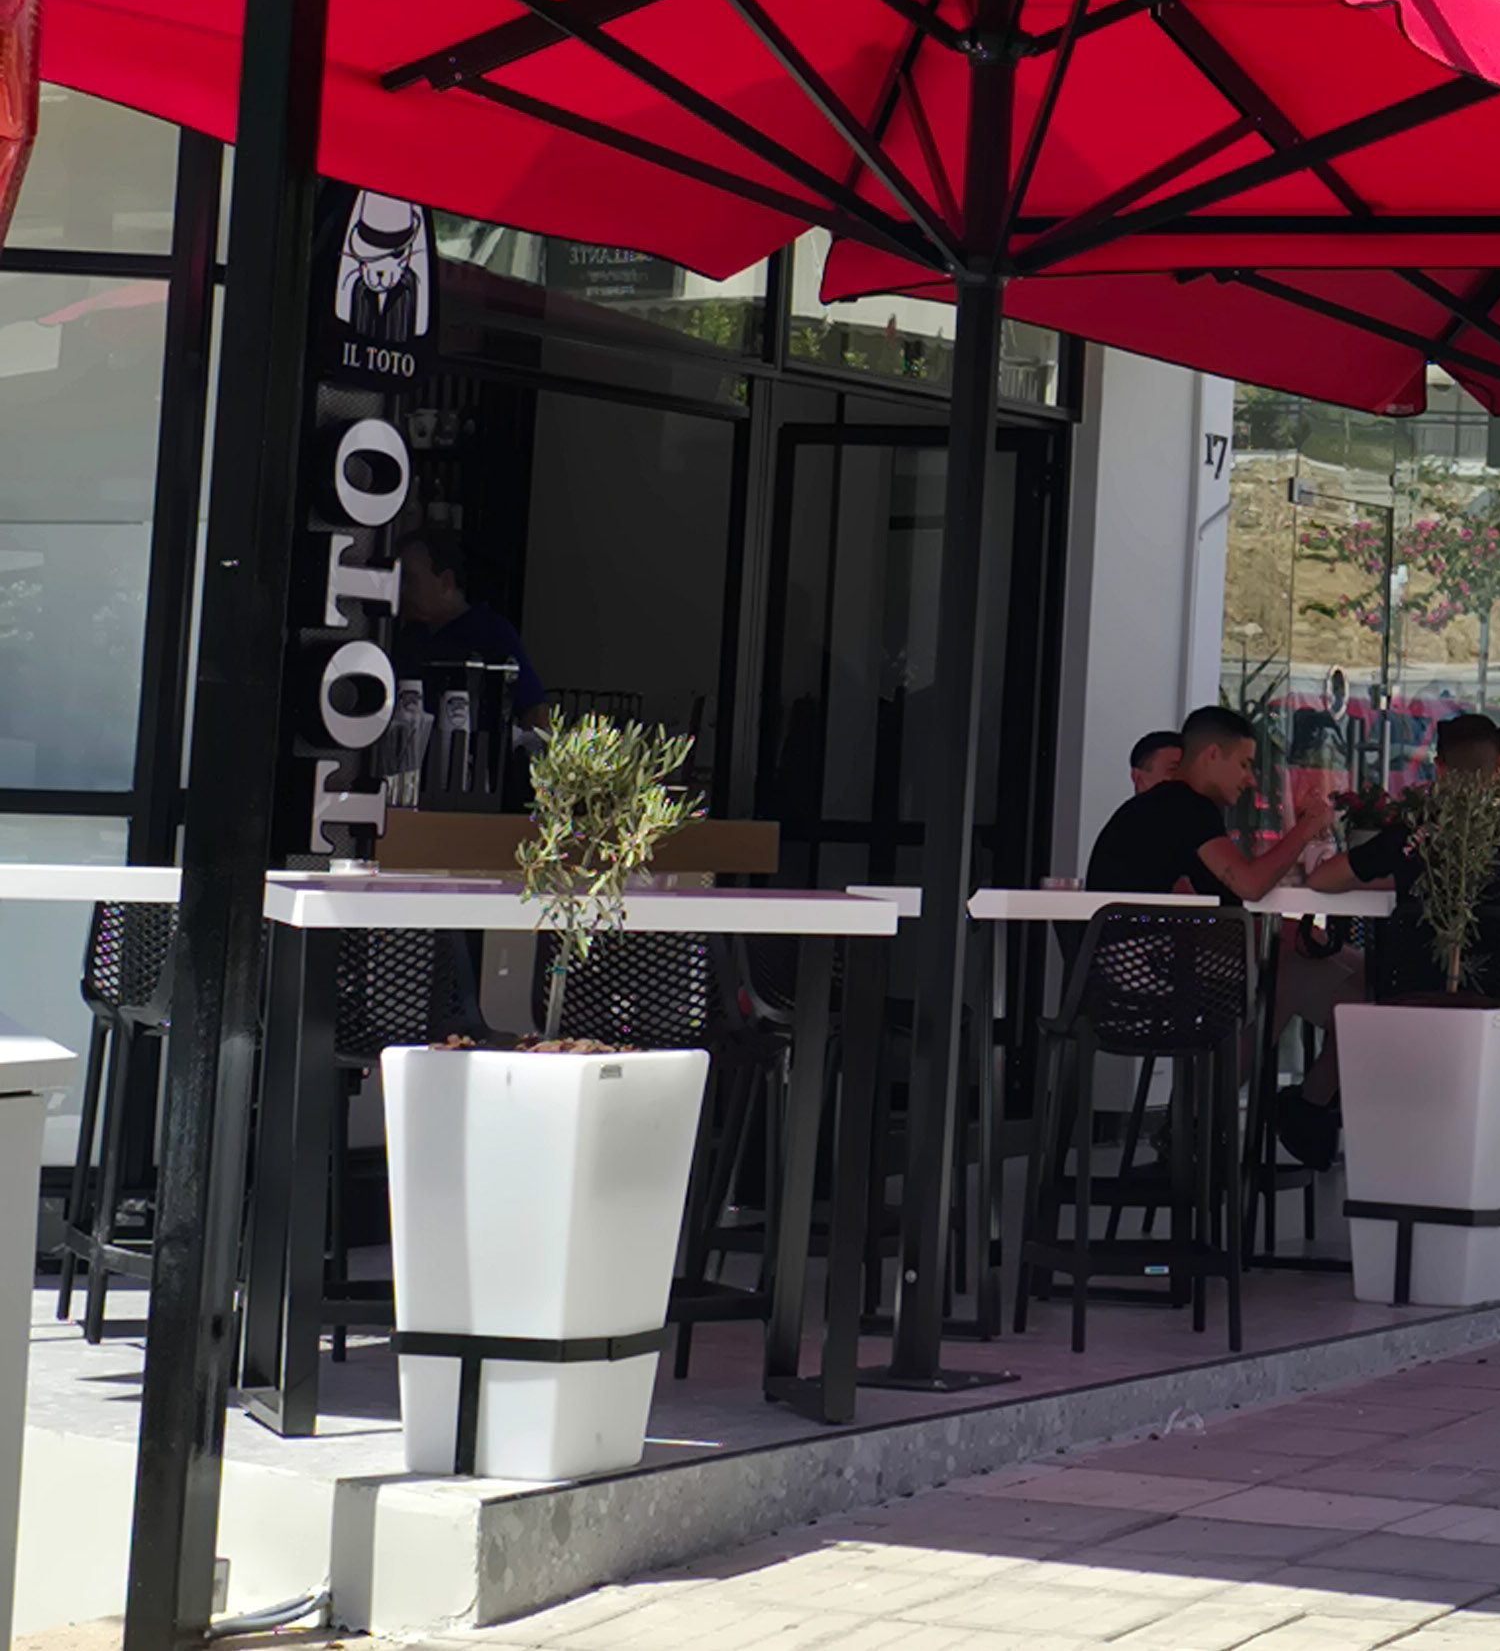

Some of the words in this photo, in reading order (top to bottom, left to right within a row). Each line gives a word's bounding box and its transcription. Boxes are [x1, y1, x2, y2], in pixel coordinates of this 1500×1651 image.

[343, 342, 361, 368] IL
[366, 346, 416, 379] TOTO
[1204, 433, 1229, 480] 17
[309, 417, 411, 855] TOTO
